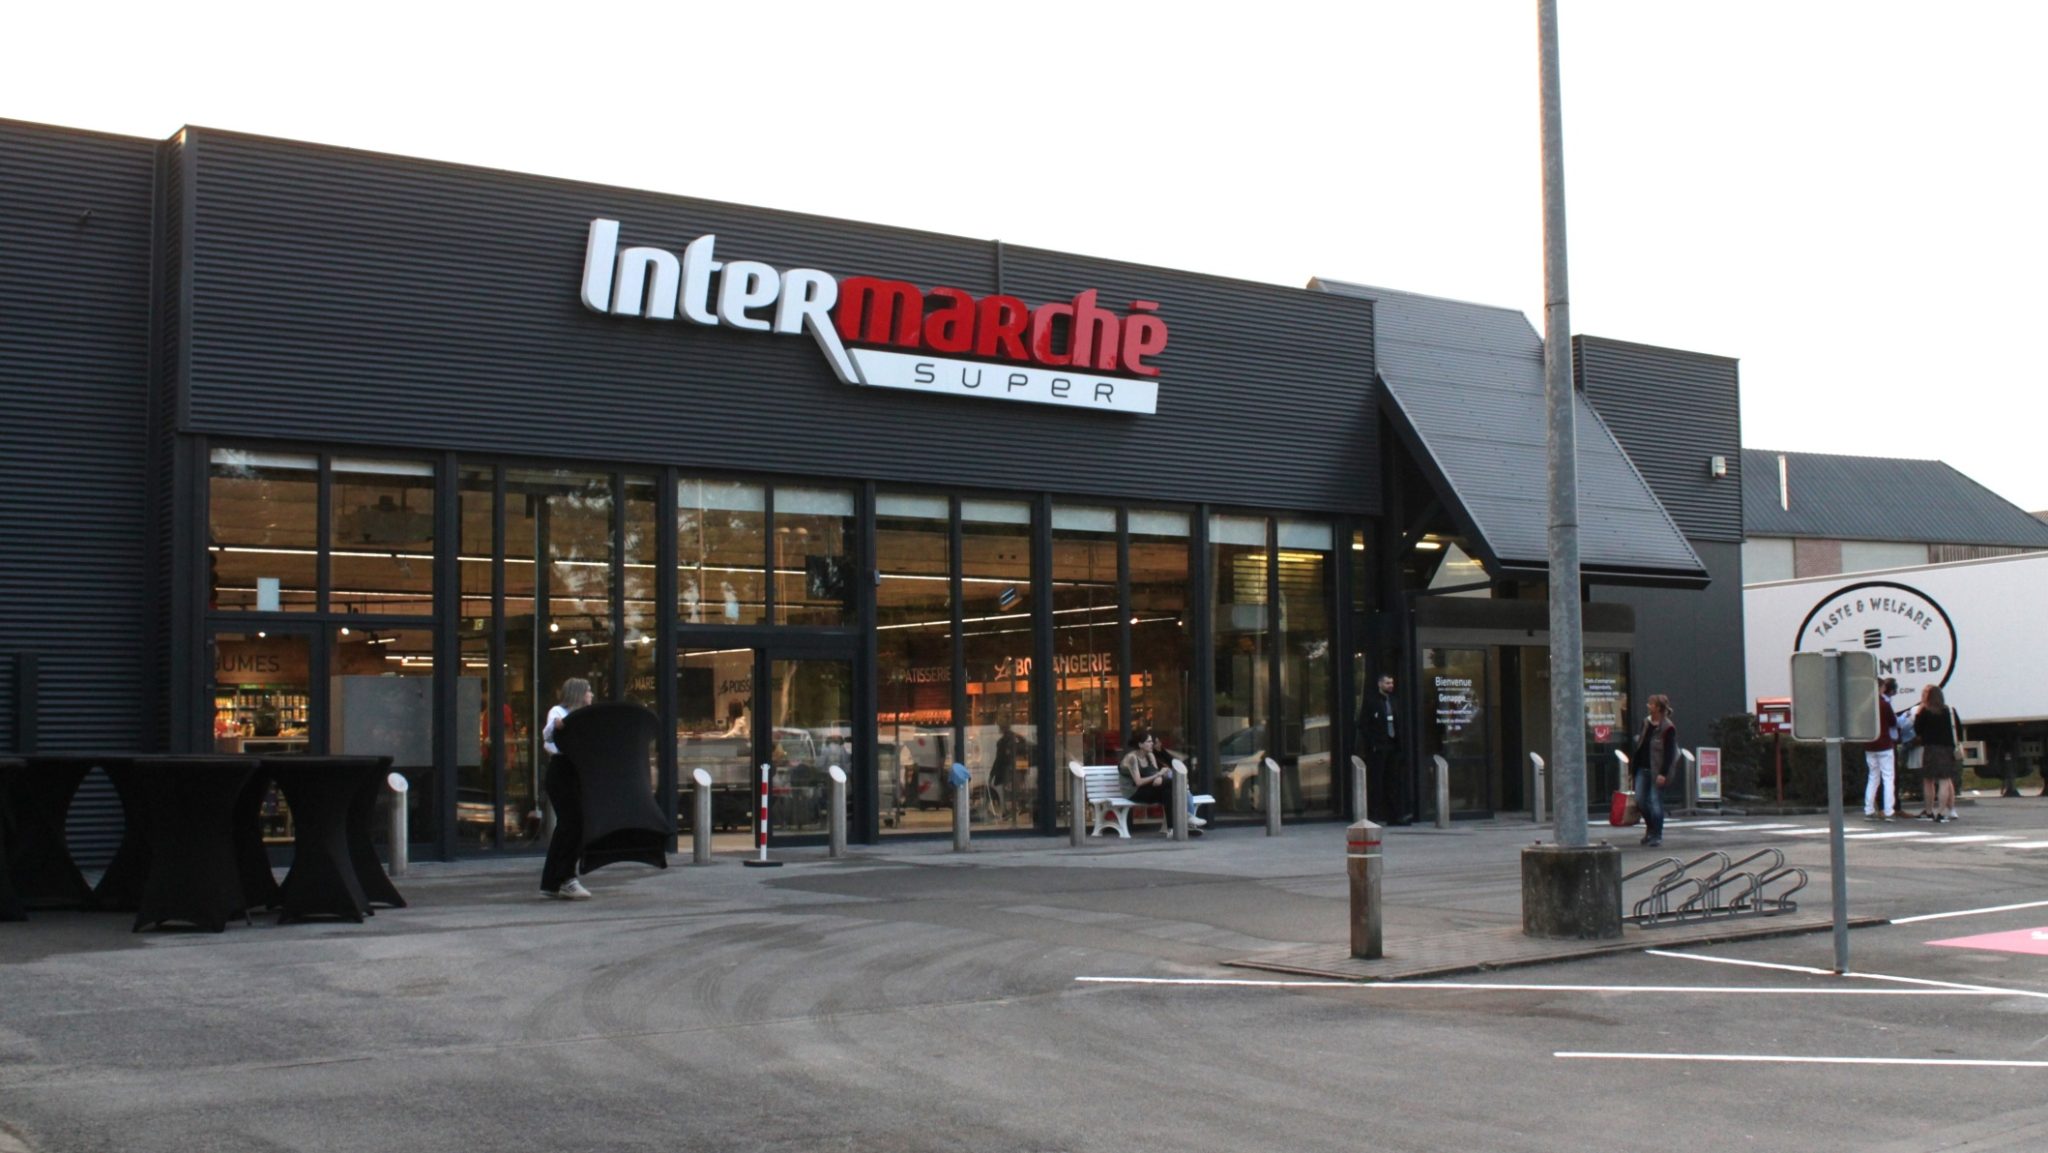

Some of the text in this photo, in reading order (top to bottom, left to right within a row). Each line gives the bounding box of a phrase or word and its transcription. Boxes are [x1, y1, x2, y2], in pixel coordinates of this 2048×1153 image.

[1814, 597, 1933, 638] TASTE & WELFARE
[1015, 653, 1113, 677] BOANGERIE
[1879, 655, 1942, 675] NTEED
[1435, 676, 1473, 687] Bienvenue
